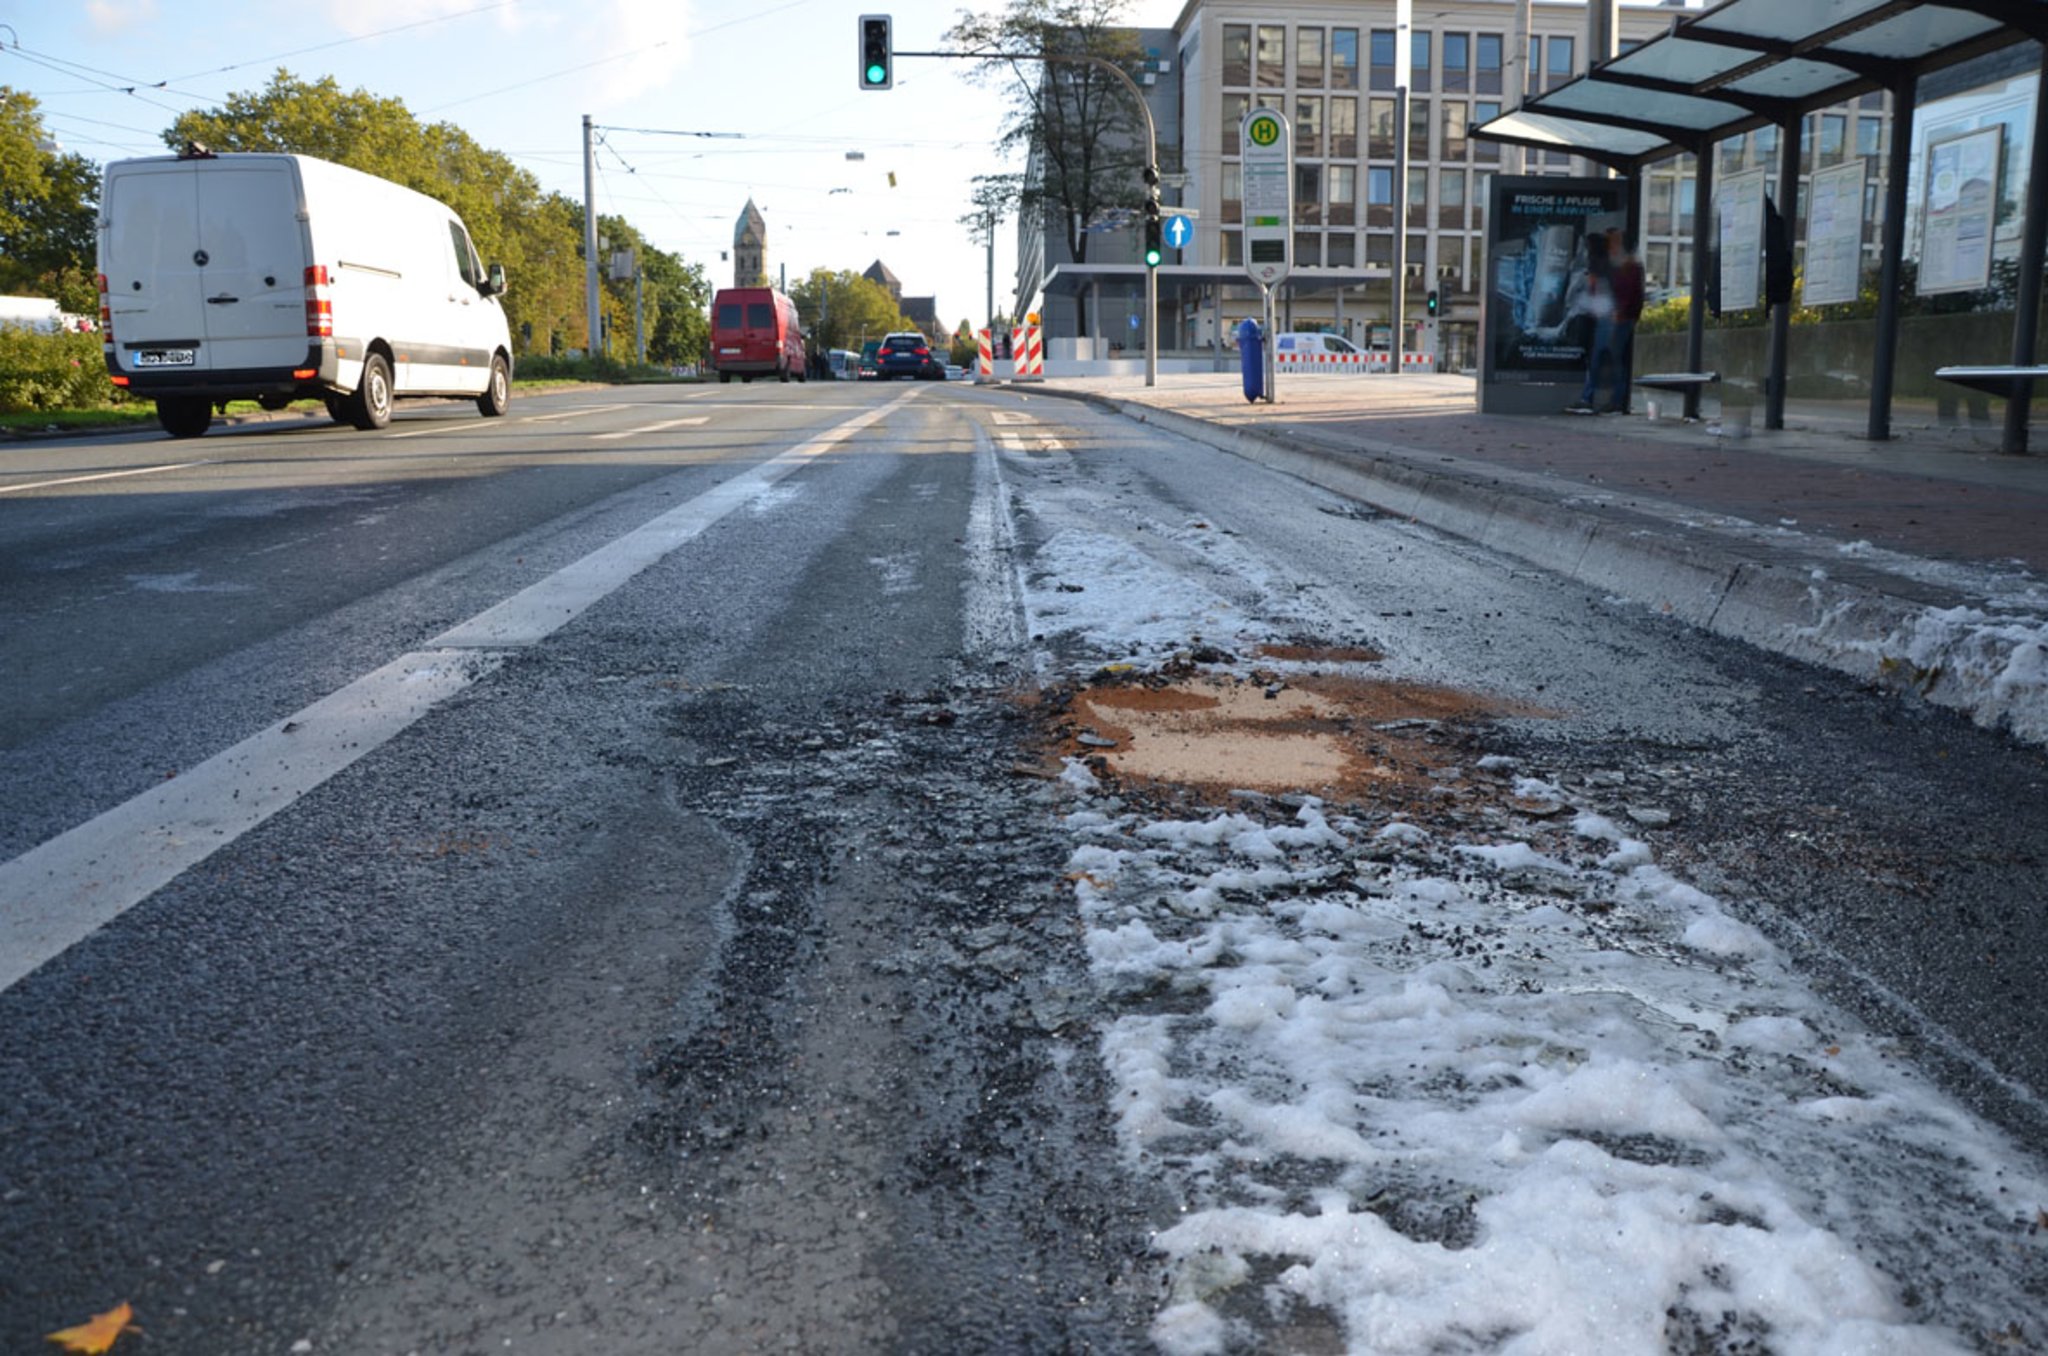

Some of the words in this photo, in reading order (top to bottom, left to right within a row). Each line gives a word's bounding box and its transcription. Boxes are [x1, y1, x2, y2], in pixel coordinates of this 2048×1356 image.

[1258, 124, 1271, 139] H
[1515, 195, 1555, 205] FRISCHE
[1566, 196, 1601, 206] PFLEGE
